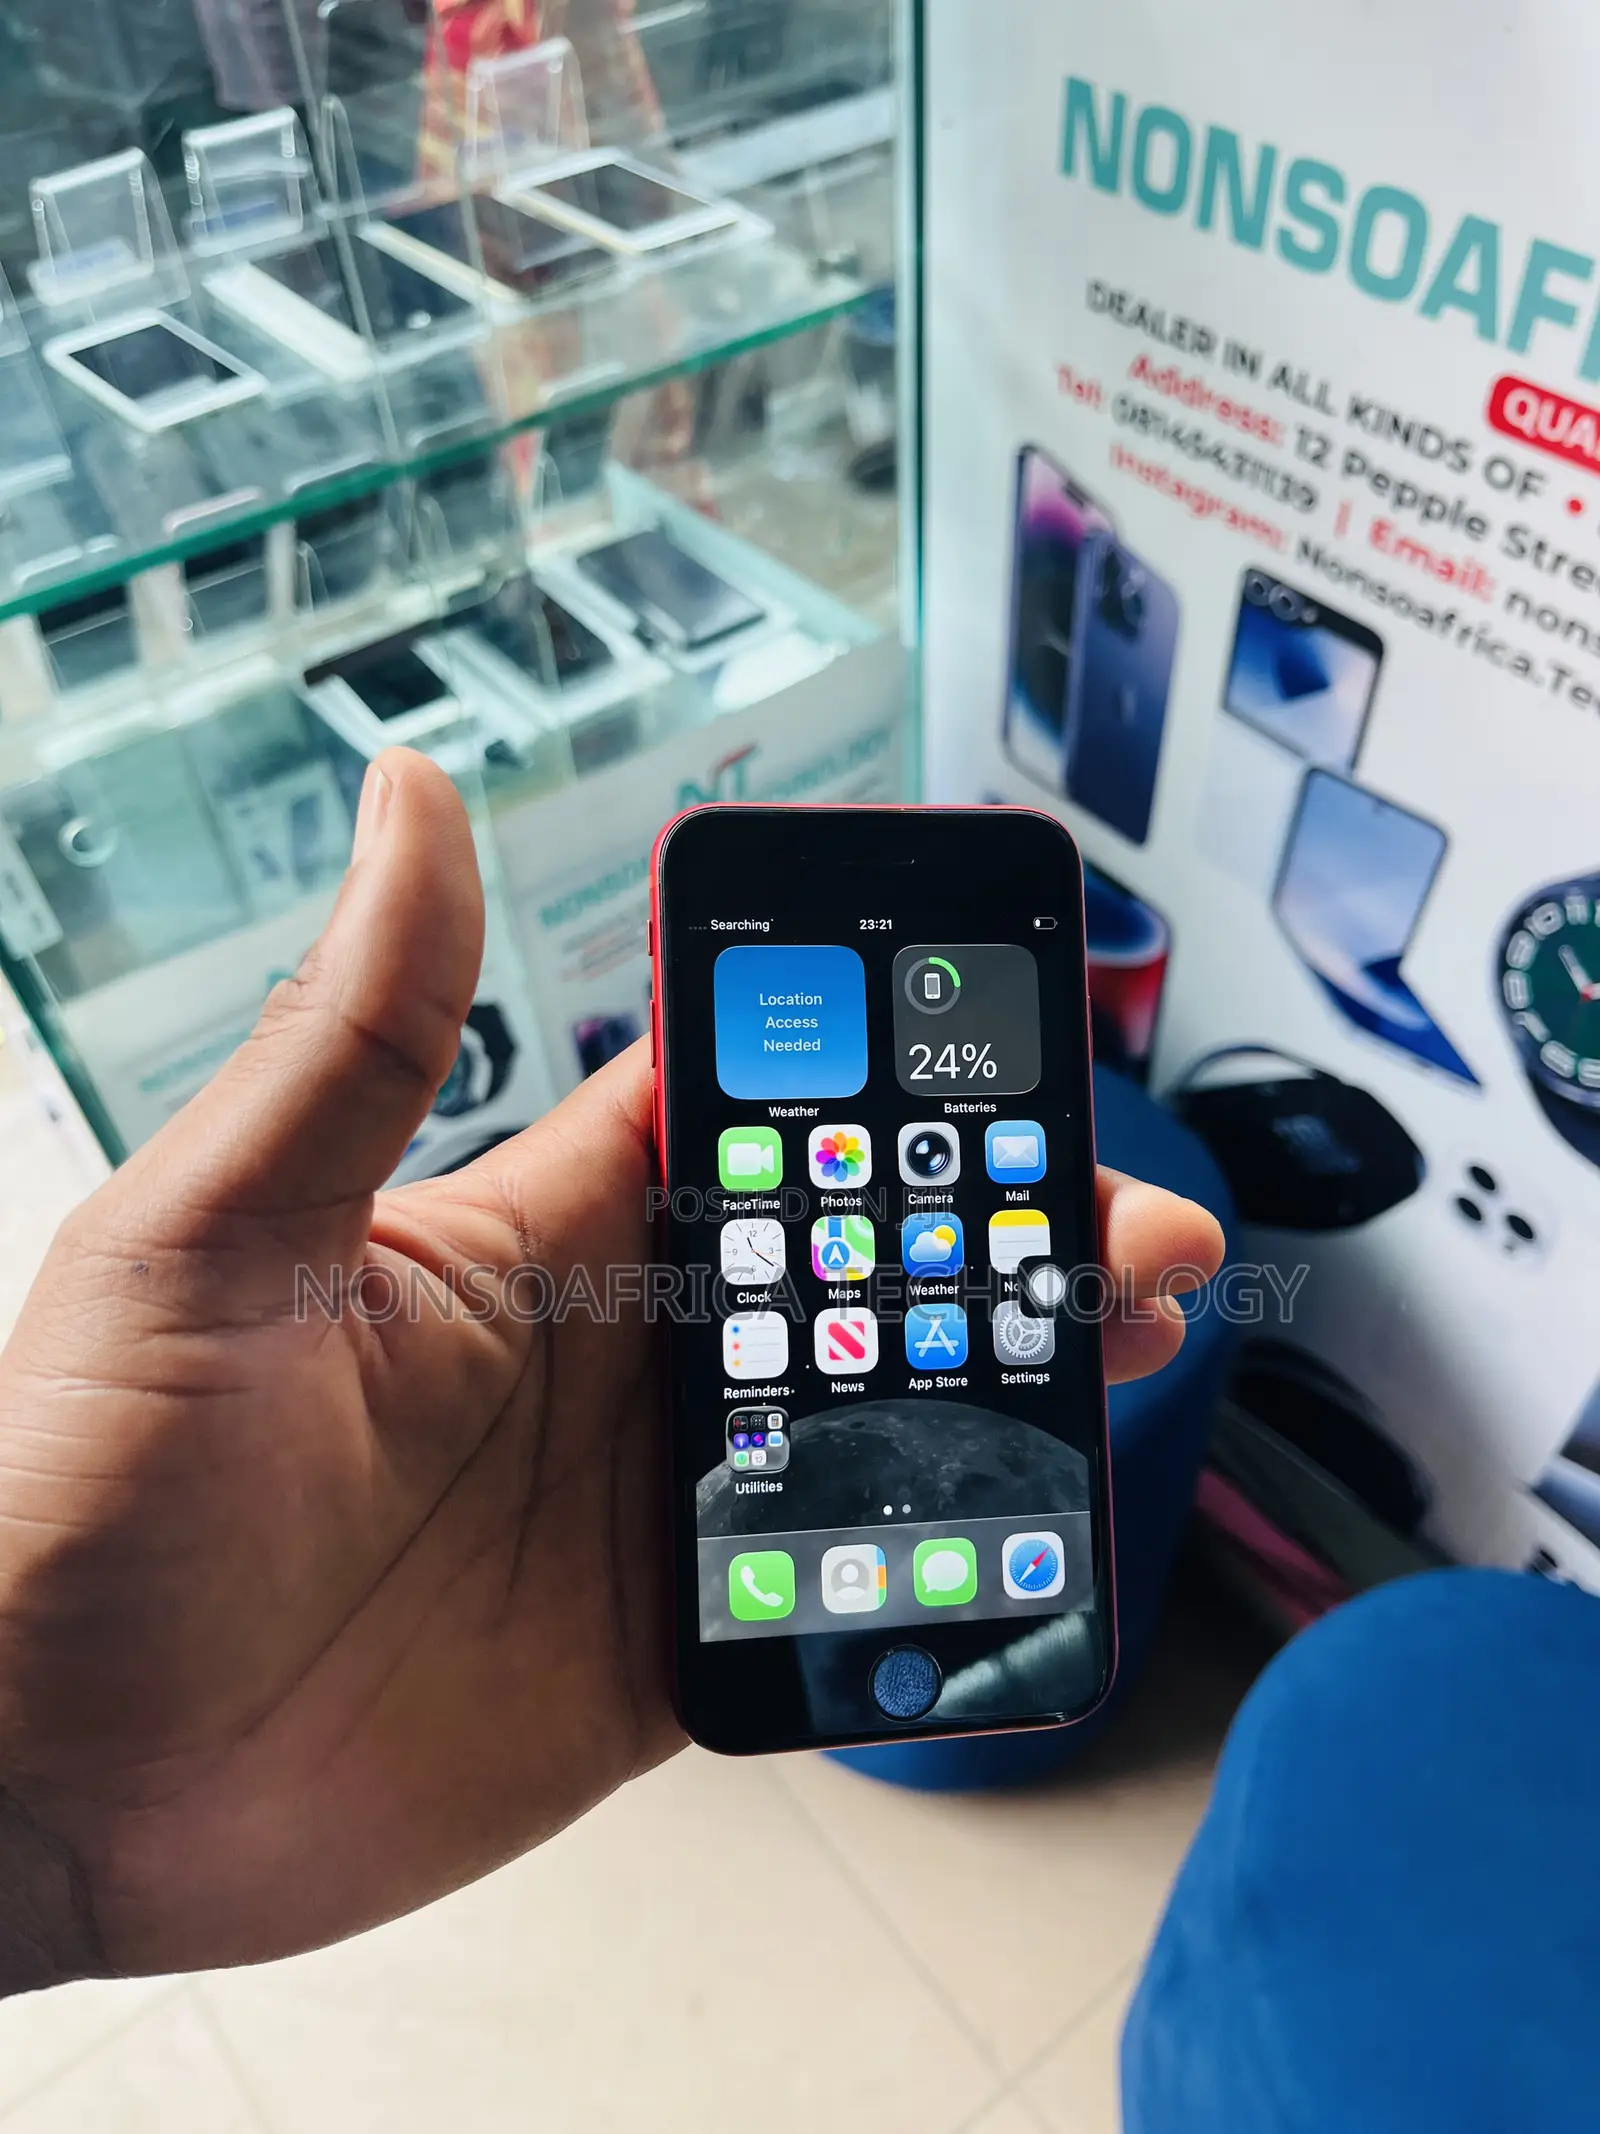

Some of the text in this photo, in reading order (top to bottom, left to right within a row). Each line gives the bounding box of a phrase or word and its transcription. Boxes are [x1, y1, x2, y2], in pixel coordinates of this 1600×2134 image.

[1058, 75, 1600, 382] NONSOAF
[1085, 279, 1548, 499] DEALER IN ALL KINDS OF
[1502, 387, 1600, 463] QUA
[1128, 354, 1600, 596] Address: 12 Pepple Stre
[1368, 508, 1496, 604] Email:
[1295, 536, 1600, 714] Nonsoafrica.Te
[710, 918, 770, 932] Searching
[859, 919, 893, 931] 23:21
[759, 992, 823, 1006] Location
[765, 1015, 819, 1029] Access
[763, 1038, 821, 1052] Needed
[908, 1043, 998, 1080] 24%
[768, 1105, 820, 1118] Weather
[944, 1101, 997, 1114] Batteries
[820, 1195, 862, 1207] Photos
[907, 1192, 954, 1205] Camera
[1005, 1190, 1030, 1202] Mail
[722, 1199, 781, 1211] FaceTime
[828, 1287, 861, 1301] Maps
[909, 1283, 960, 1296] Weather
[736, 1290, 772, 1304] Clock
[908, 1376, 968, 1390] App Store
[1001, 1372, 1051, 1385] Settings
[723, 1385, 790, 1400] Reminders
[831, 1381, 865, 1393] News
[735, 1481, 784, 1494] Utilities
